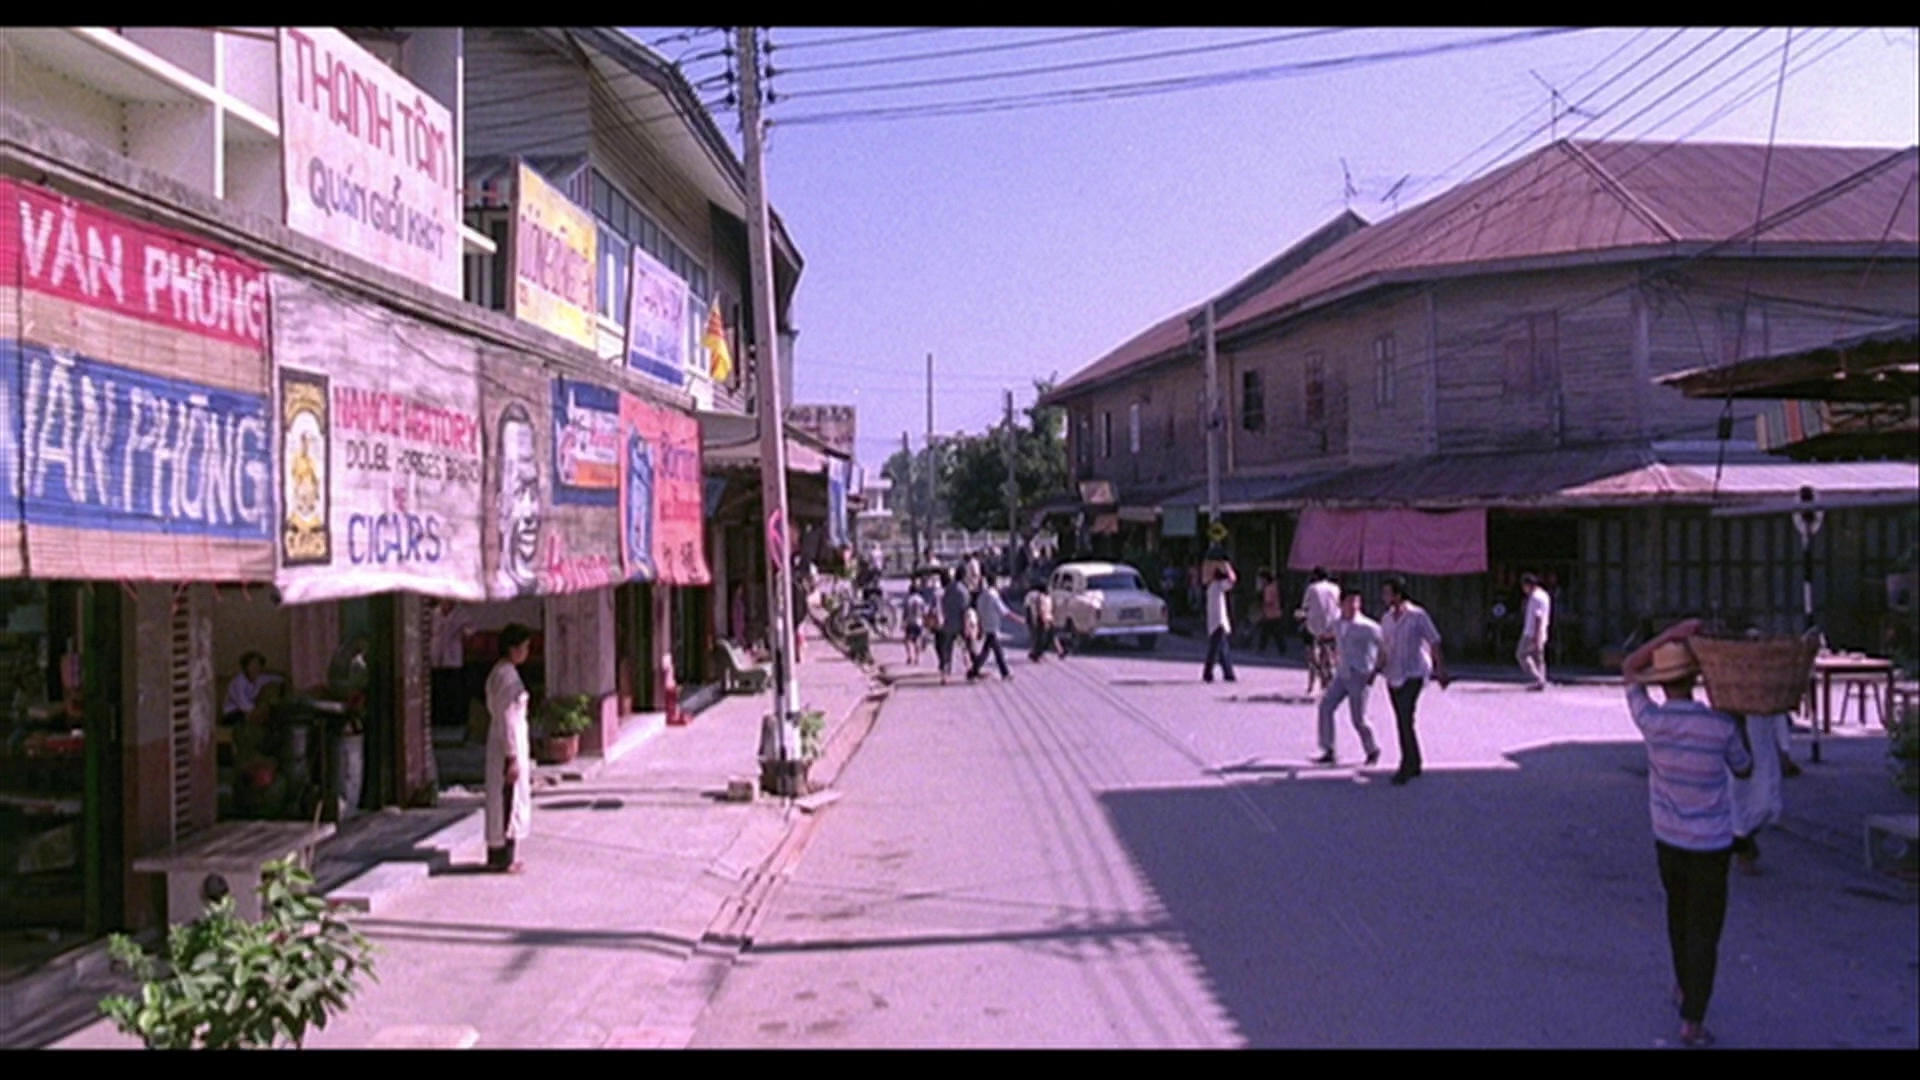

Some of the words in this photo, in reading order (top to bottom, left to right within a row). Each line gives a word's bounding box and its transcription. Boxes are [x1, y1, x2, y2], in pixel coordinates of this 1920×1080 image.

[287, 28, 394, 156] THANH
[397, 95, 449, 190] TÂM
[19, 196, 124, 304] VĂN
